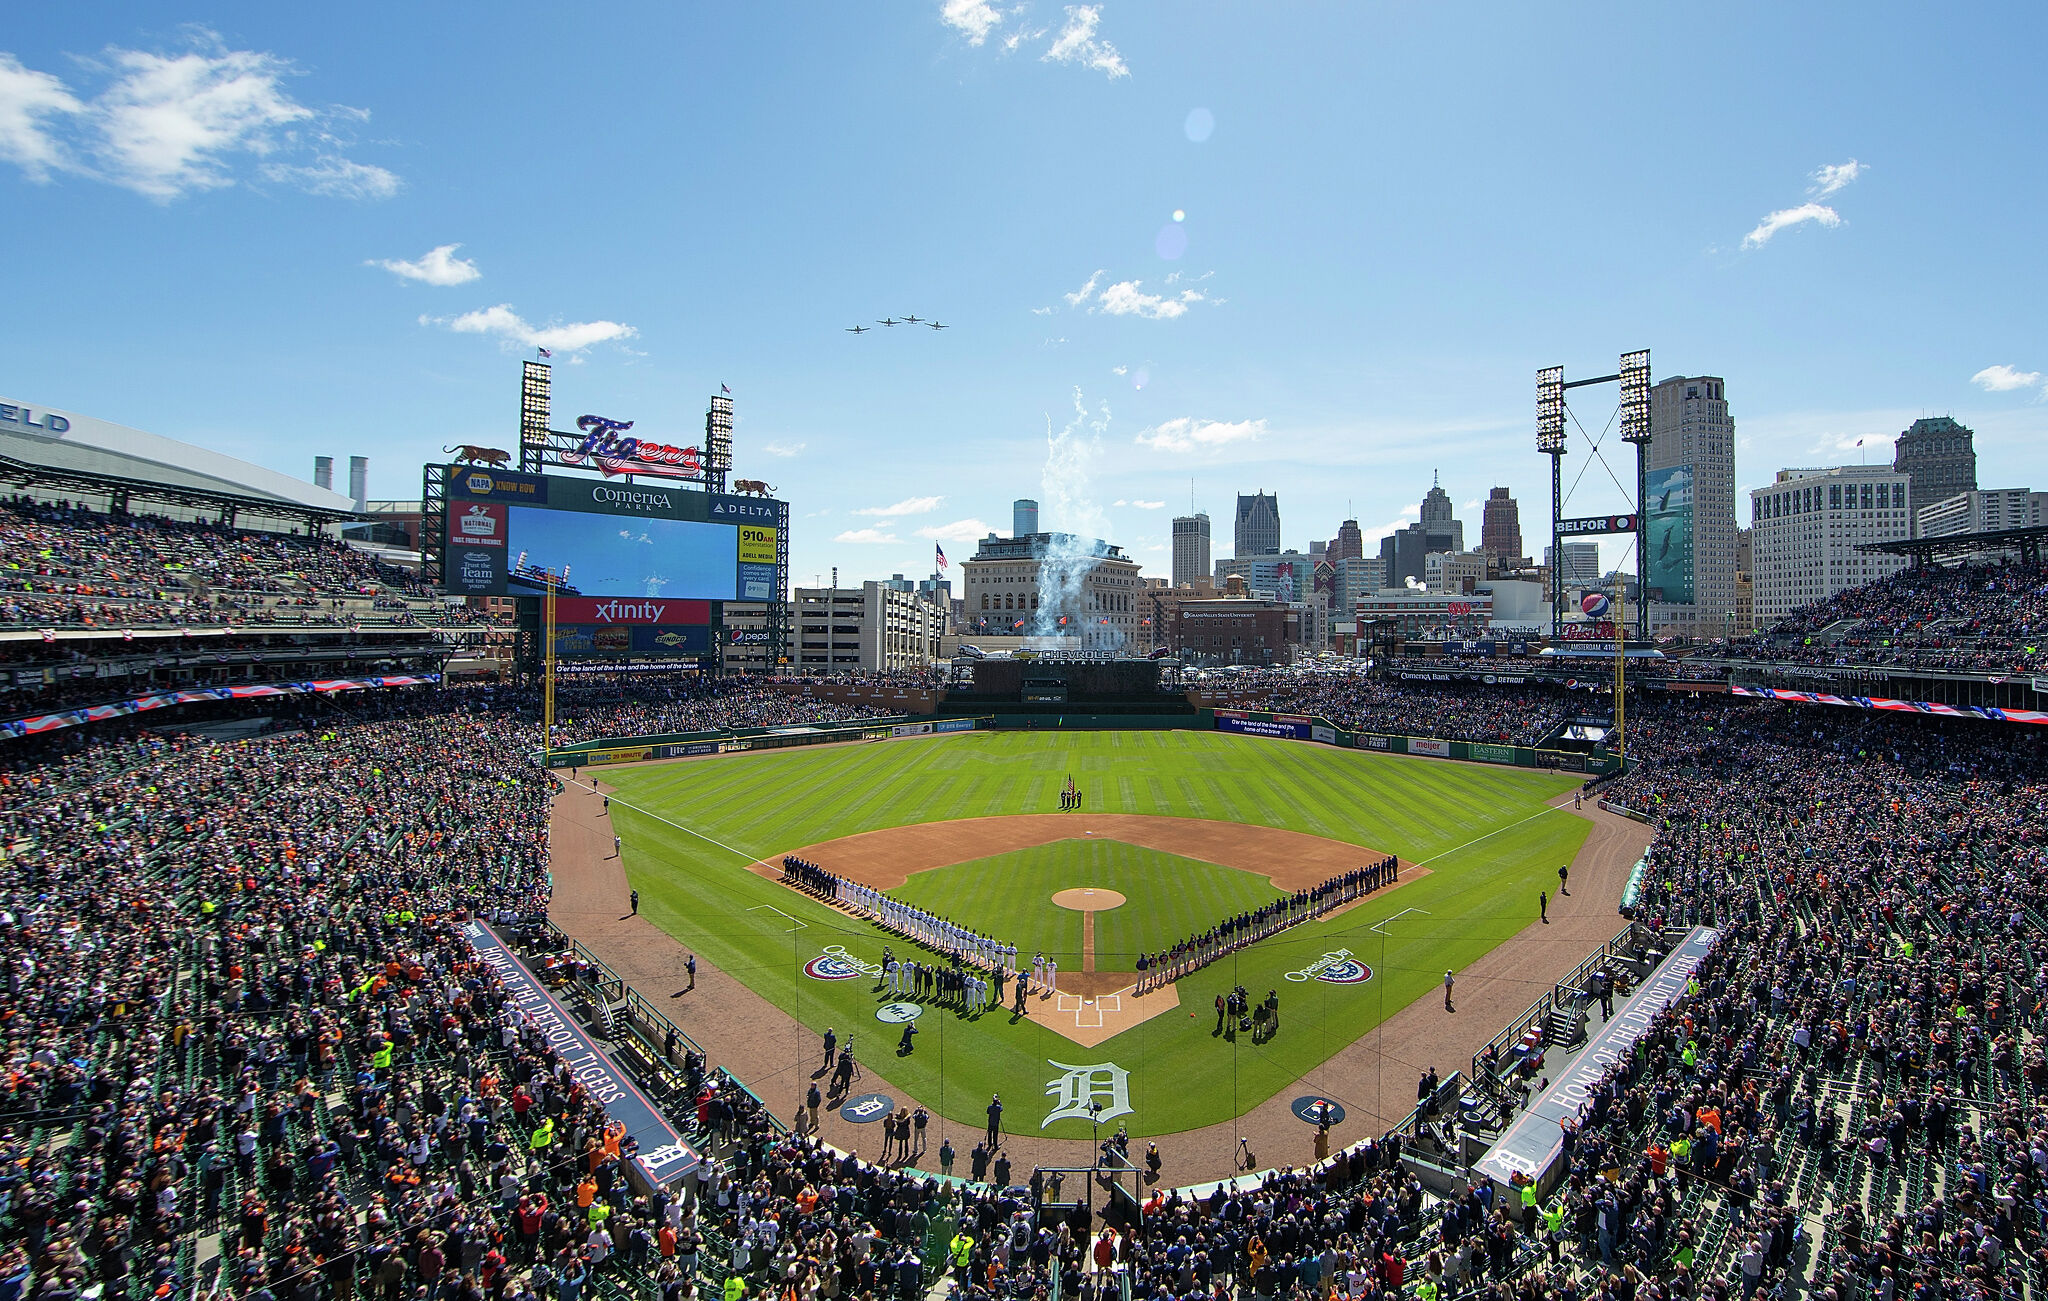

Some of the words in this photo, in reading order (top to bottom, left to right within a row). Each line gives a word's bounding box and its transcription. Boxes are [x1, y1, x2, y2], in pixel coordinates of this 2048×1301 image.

[0, 403, 70, 432] ELD
[560, 414, 700, 476] Tigers
[470, 478, 490, 489] NAPA
[496, 480, 517, 492] KNOW
[615, 502, 652, 511] PARK
[728, 504, 772, 517] DELTA
[464, 519, 492, 529] NATIONAL
[1555, 520, 1607, 533] BELFOR
[742, 530, 764, 542] 910
[743, 541, 774, 549] Superstation
[460, 567, 493, 578] Team
[743, 564, 772, 572] Confidence
[595, 599, 666, 623] xfinity
[1448, 602, 1471, 615] AAA
[656, 635, 687, 643] SUNOCO
[745, 632, 770, 641] pepsi
[1462, 641, 1477, 649] Lite
[1042, 650, 1117, 660] CHEVROLET
[556, 665, 570, 673] O'er
[582, 664, 596, 672] land
[1432, 673, 1450, 681] Bank
[1497, 676, 1525, 684] DETROIT
[1869, 672, 1889, 681] CLUB
[1579, 681, 1599, 689] pepsi
[1368, 741, 1387, 749] FAST!
[1415, 740, 1441, 750] meijer
[1474, 745, 1509, 756] EASTERN
[590, 753, 612, 762] DMC
[620, 751, 642, 759] MINUTE
[669, 745, 685, 757] Lite
[483, 946, 512, 971] HOME
[823, 945, 867, 969] Opening
[1284, 957, 1339, 982] Opening
[1321, 947, 1354, 962] Day
[500, 971, 525, 987] OF
[514, 983, 541, 1005] THE
[885, 1004, 905, 1017] Mr.
[900, 1013, 915, 1021] I
[526, 1002, 585, 1054] DETROIT
[1549, 1065, 1603, 1112] HOME
[1592, 1046, 1619, 1067] OF
[1606, 1022, 1641, 1050] THE
[1624, 981, 1677, 1024] DETROIT
[1660, 953, 1700, 982] TIGERS
[570, 1051, 626, 1105] TIGERS
[735, 1250, 740, 1258] 7
